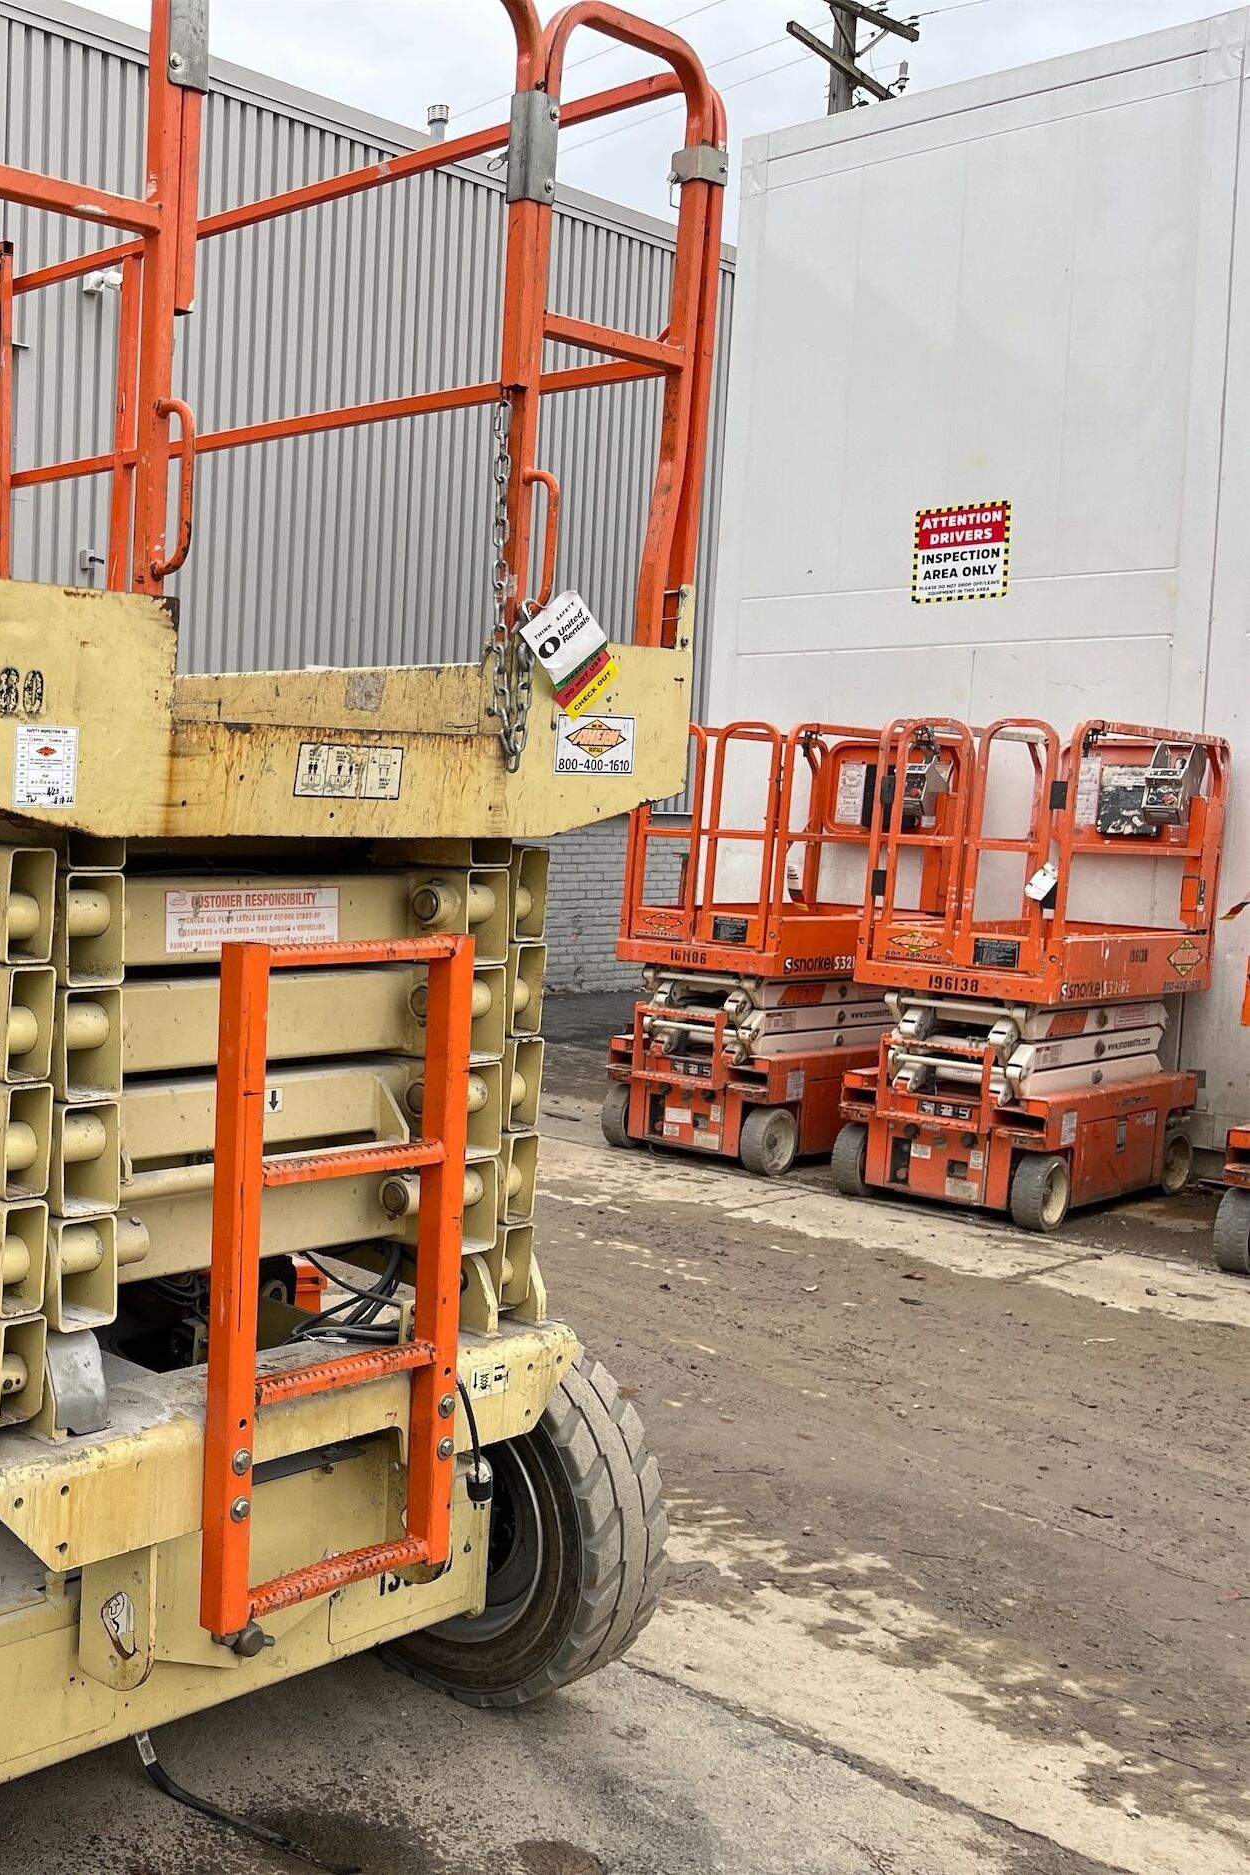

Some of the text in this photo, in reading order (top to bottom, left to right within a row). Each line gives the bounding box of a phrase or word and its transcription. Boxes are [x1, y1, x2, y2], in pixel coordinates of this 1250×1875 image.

[921, 510, 1003, 530] ATTENTION
[929, 527, 993, 545] DRIVERS
[921, 547, 1000, 565] INSPECTION
[923, 564, 997, 580] AREA ONLY
[533, 601, 575, 640] THINK SAFETY
[557, 608, 583, 636] United
[562, 616, 590, 643] Rentals
[564, 688, 574, 699] DO
[574, 671, 588, 688] NOT
[574, 686, 597, 711] CHECK
[597, 671, 611, 686] OUT
[558, 758, 630, 771] 800-400-1610
[245, 892, 317, 907] RESPONSIBILITY
[236, 914, 256, 922] LEVELS
[257, 913, 272, 921] DAILY
[274, 913, 295, 921] BEFORE
[170, 942, 194, 950] DAMAGE
[793, 955, 834, 972] snorkel
[928, 974, 979, 993] 196138
[1068, 982, 1103, 998] snorkel
